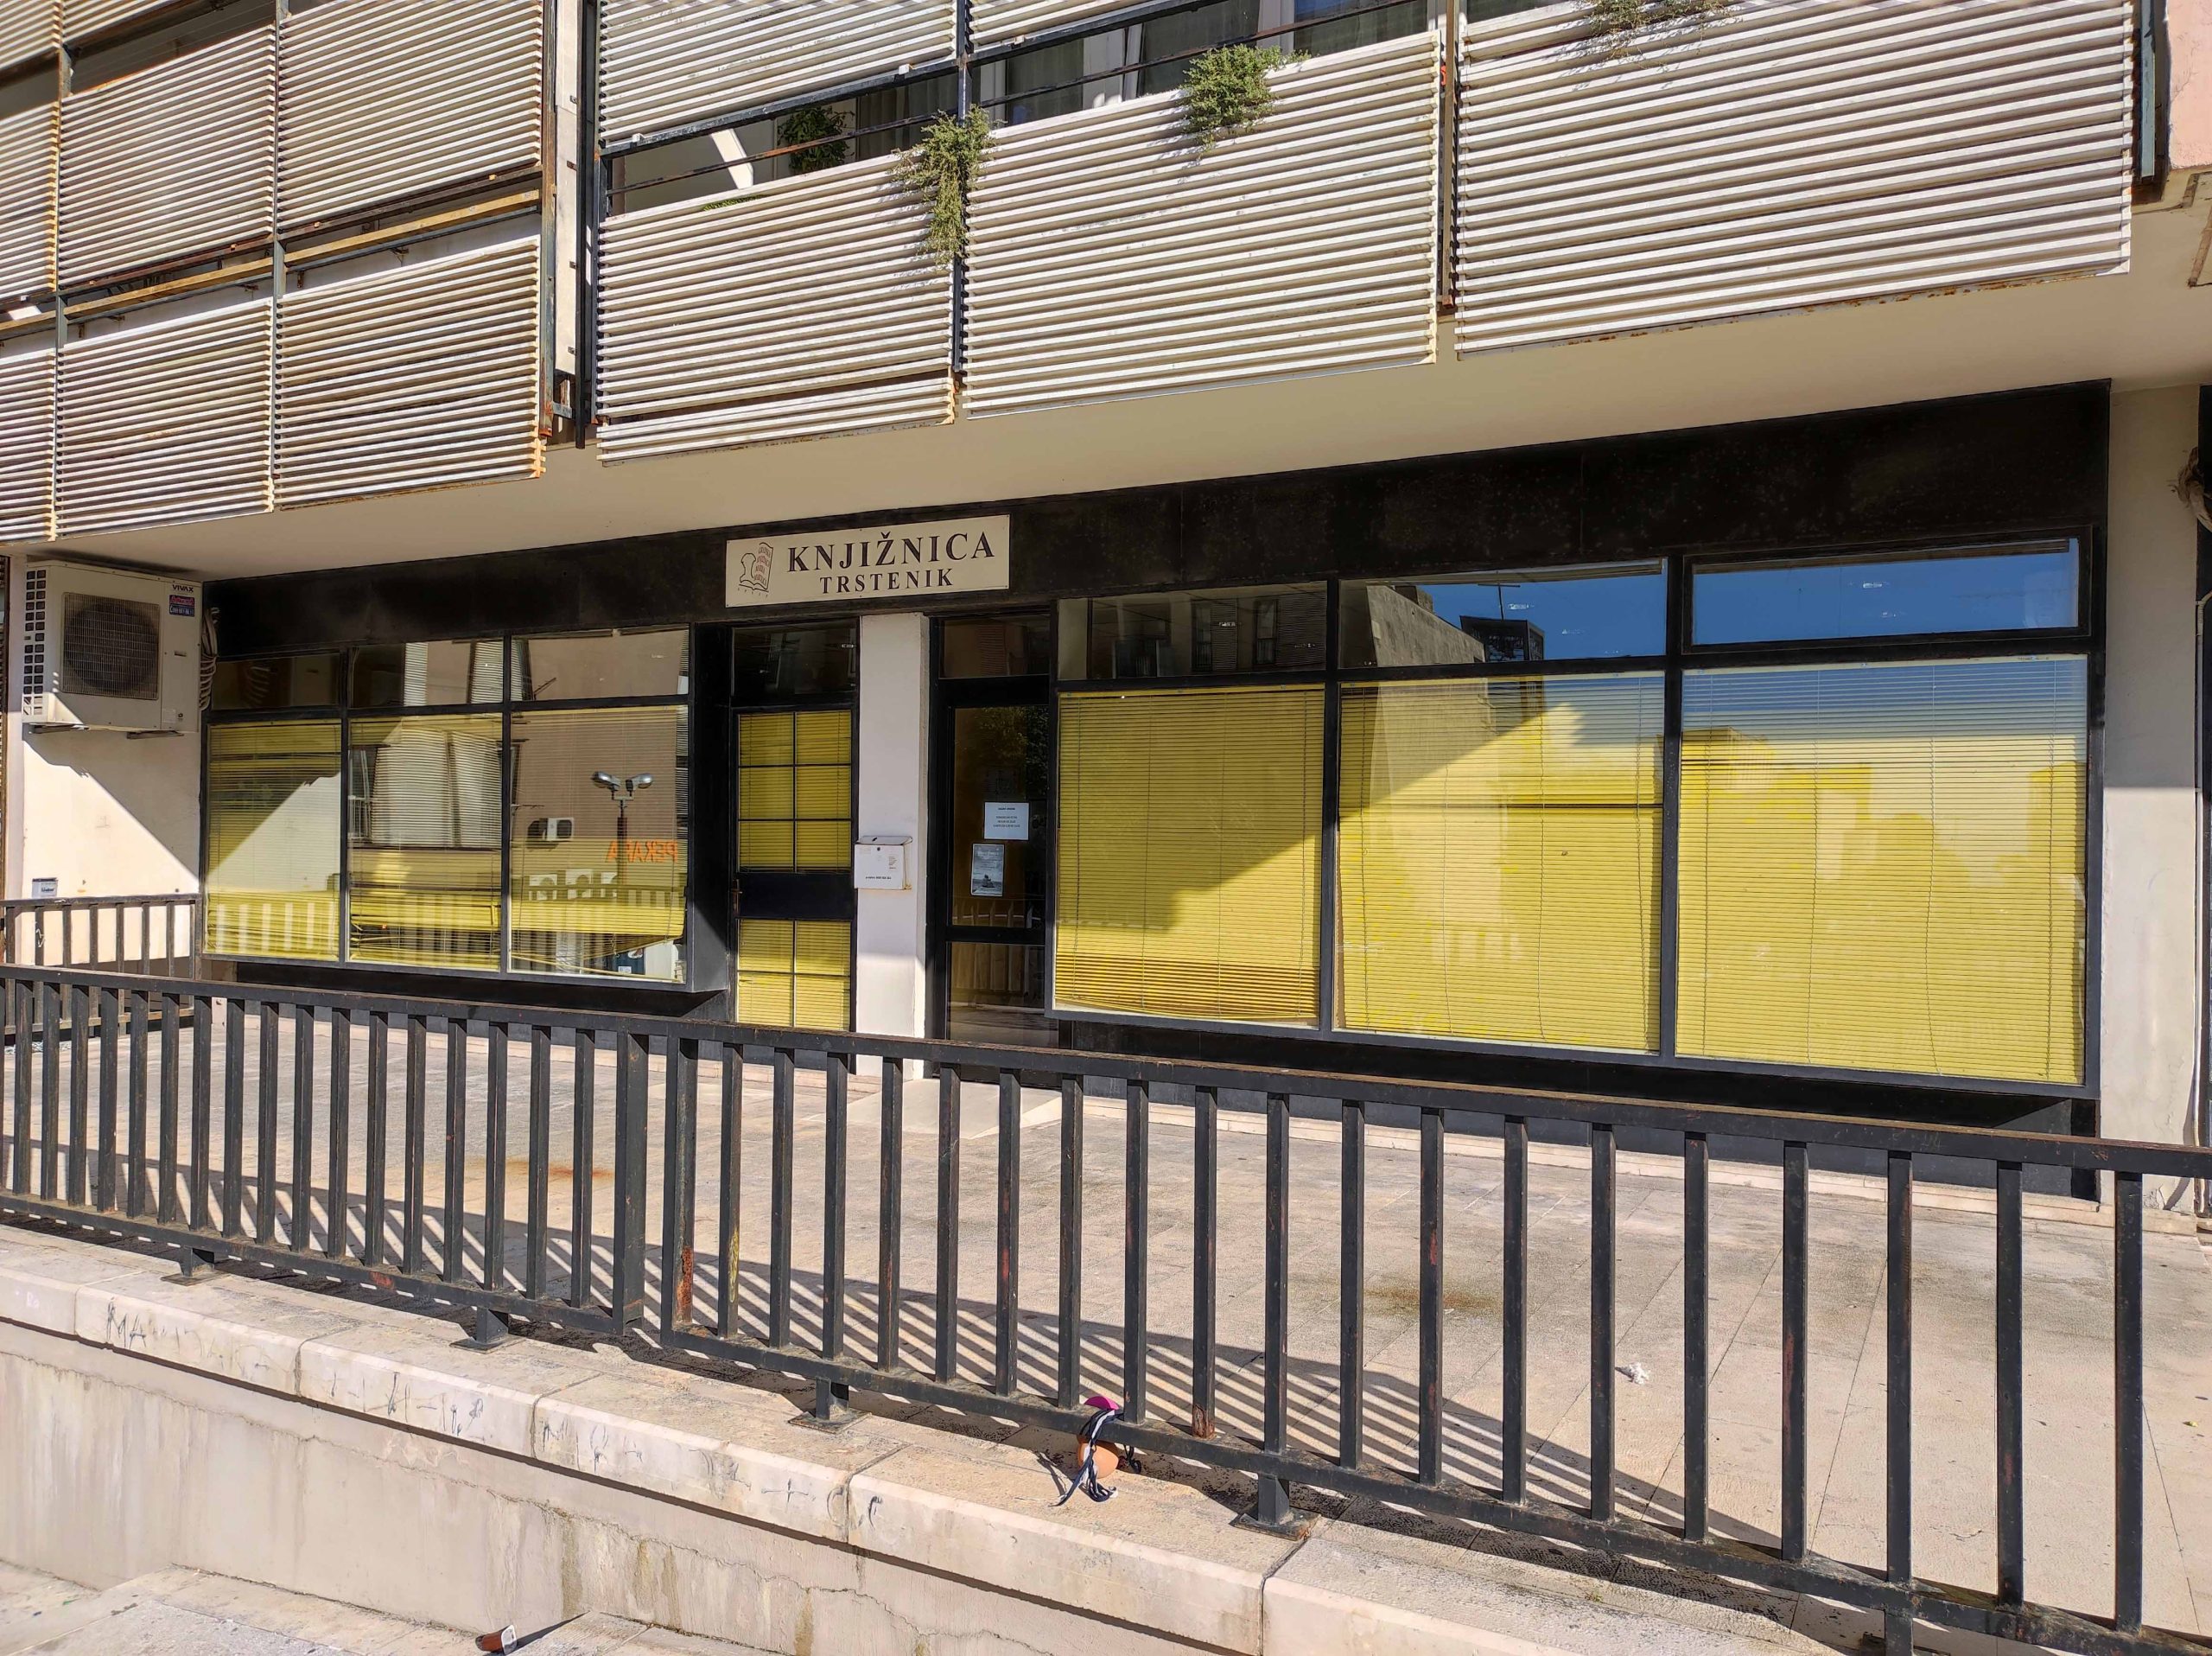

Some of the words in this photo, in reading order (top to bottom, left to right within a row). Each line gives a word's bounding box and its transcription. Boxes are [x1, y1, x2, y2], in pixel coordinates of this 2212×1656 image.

[787, 532, 995, 572] KNJIŽNICA
[172, 584, 194, 593] VIVAX
[820, 568, 953, 594] TRSTENIK
